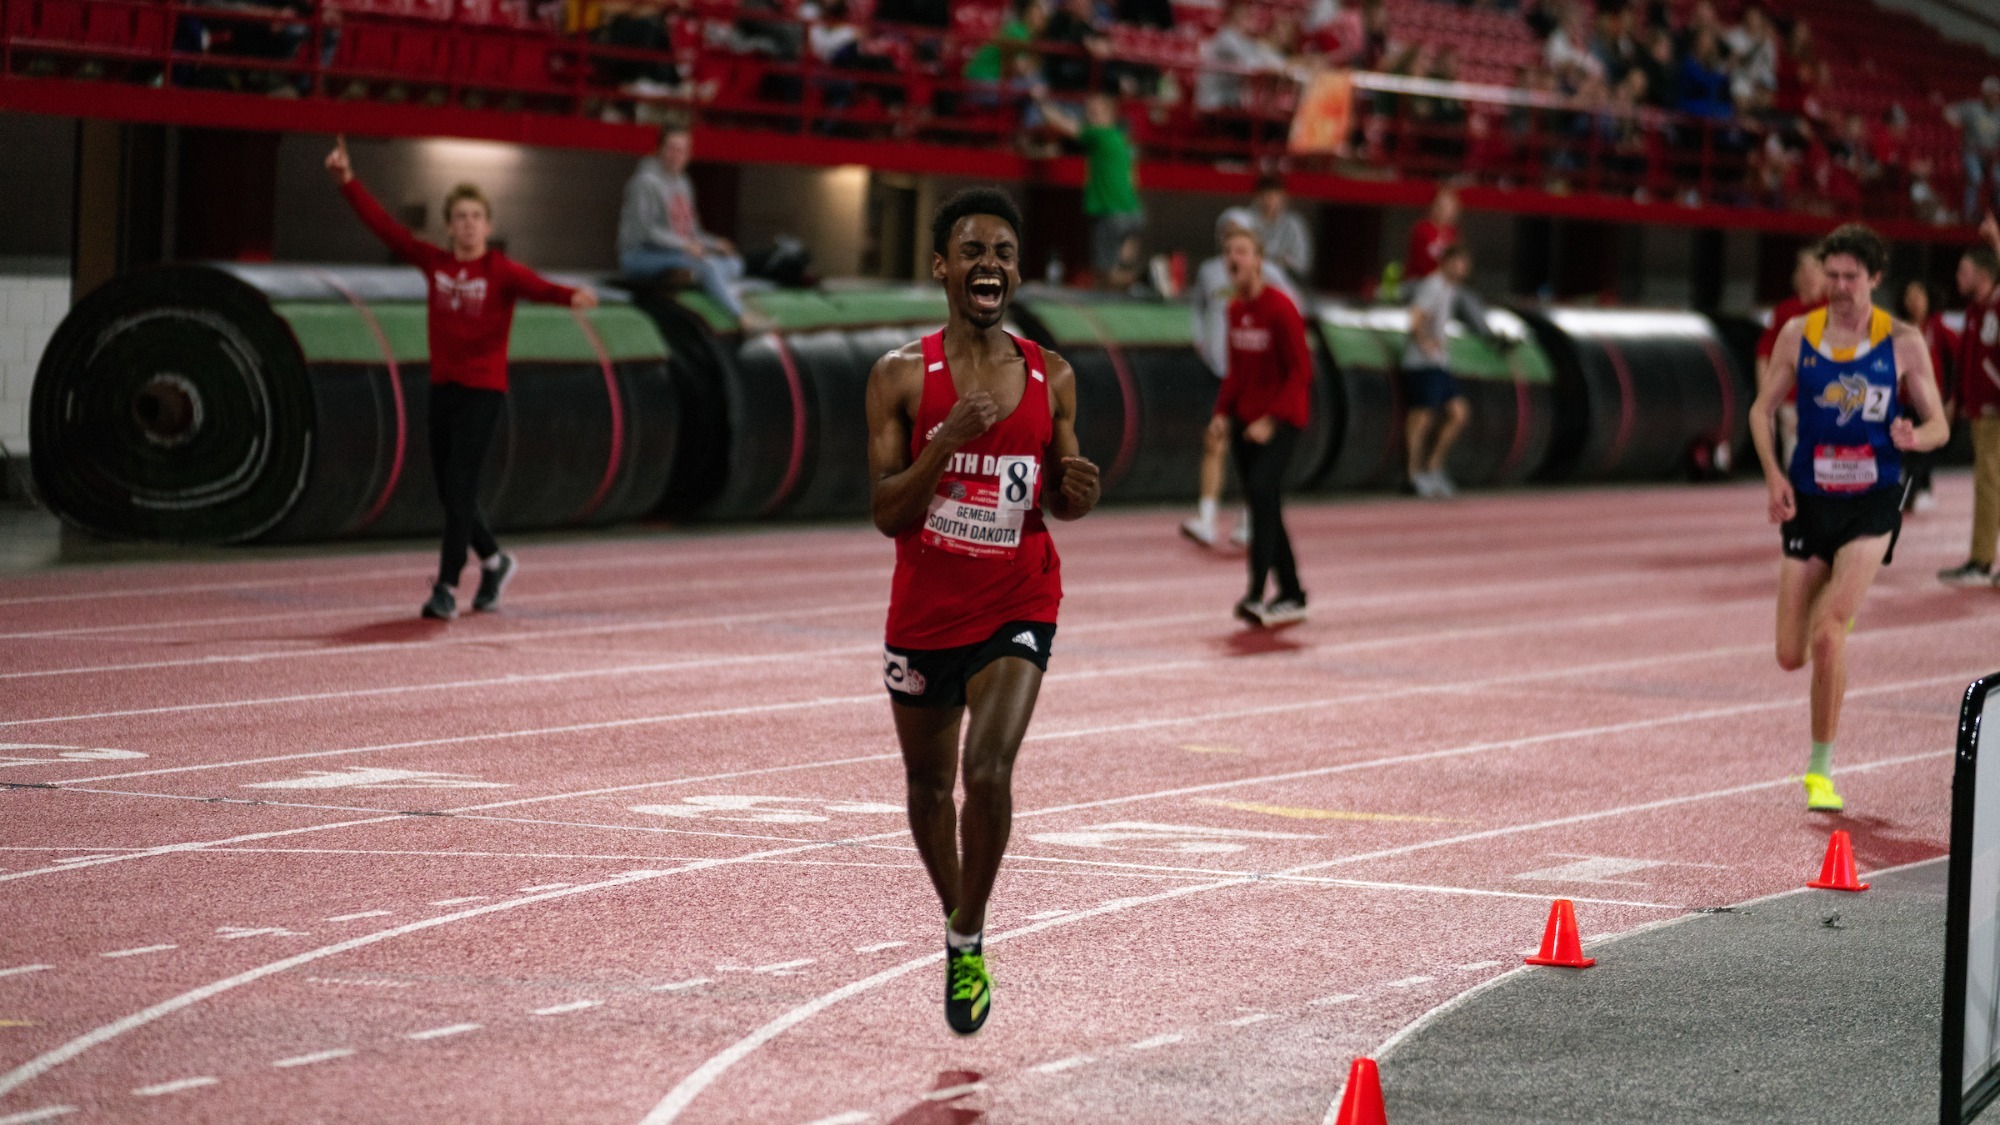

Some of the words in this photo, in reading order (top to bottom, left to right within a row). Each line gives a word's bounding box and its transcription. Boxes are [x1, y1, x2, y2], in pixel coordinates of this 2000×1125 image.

[1868, 391, 1883, 414] 2
[1005, 461, 1028, 503] 8
[957, 506, 996, 523] GEMEDA
[929, 513, 968, 537] SOUTH
[970, 525, 1016, 544] DAKOTA
